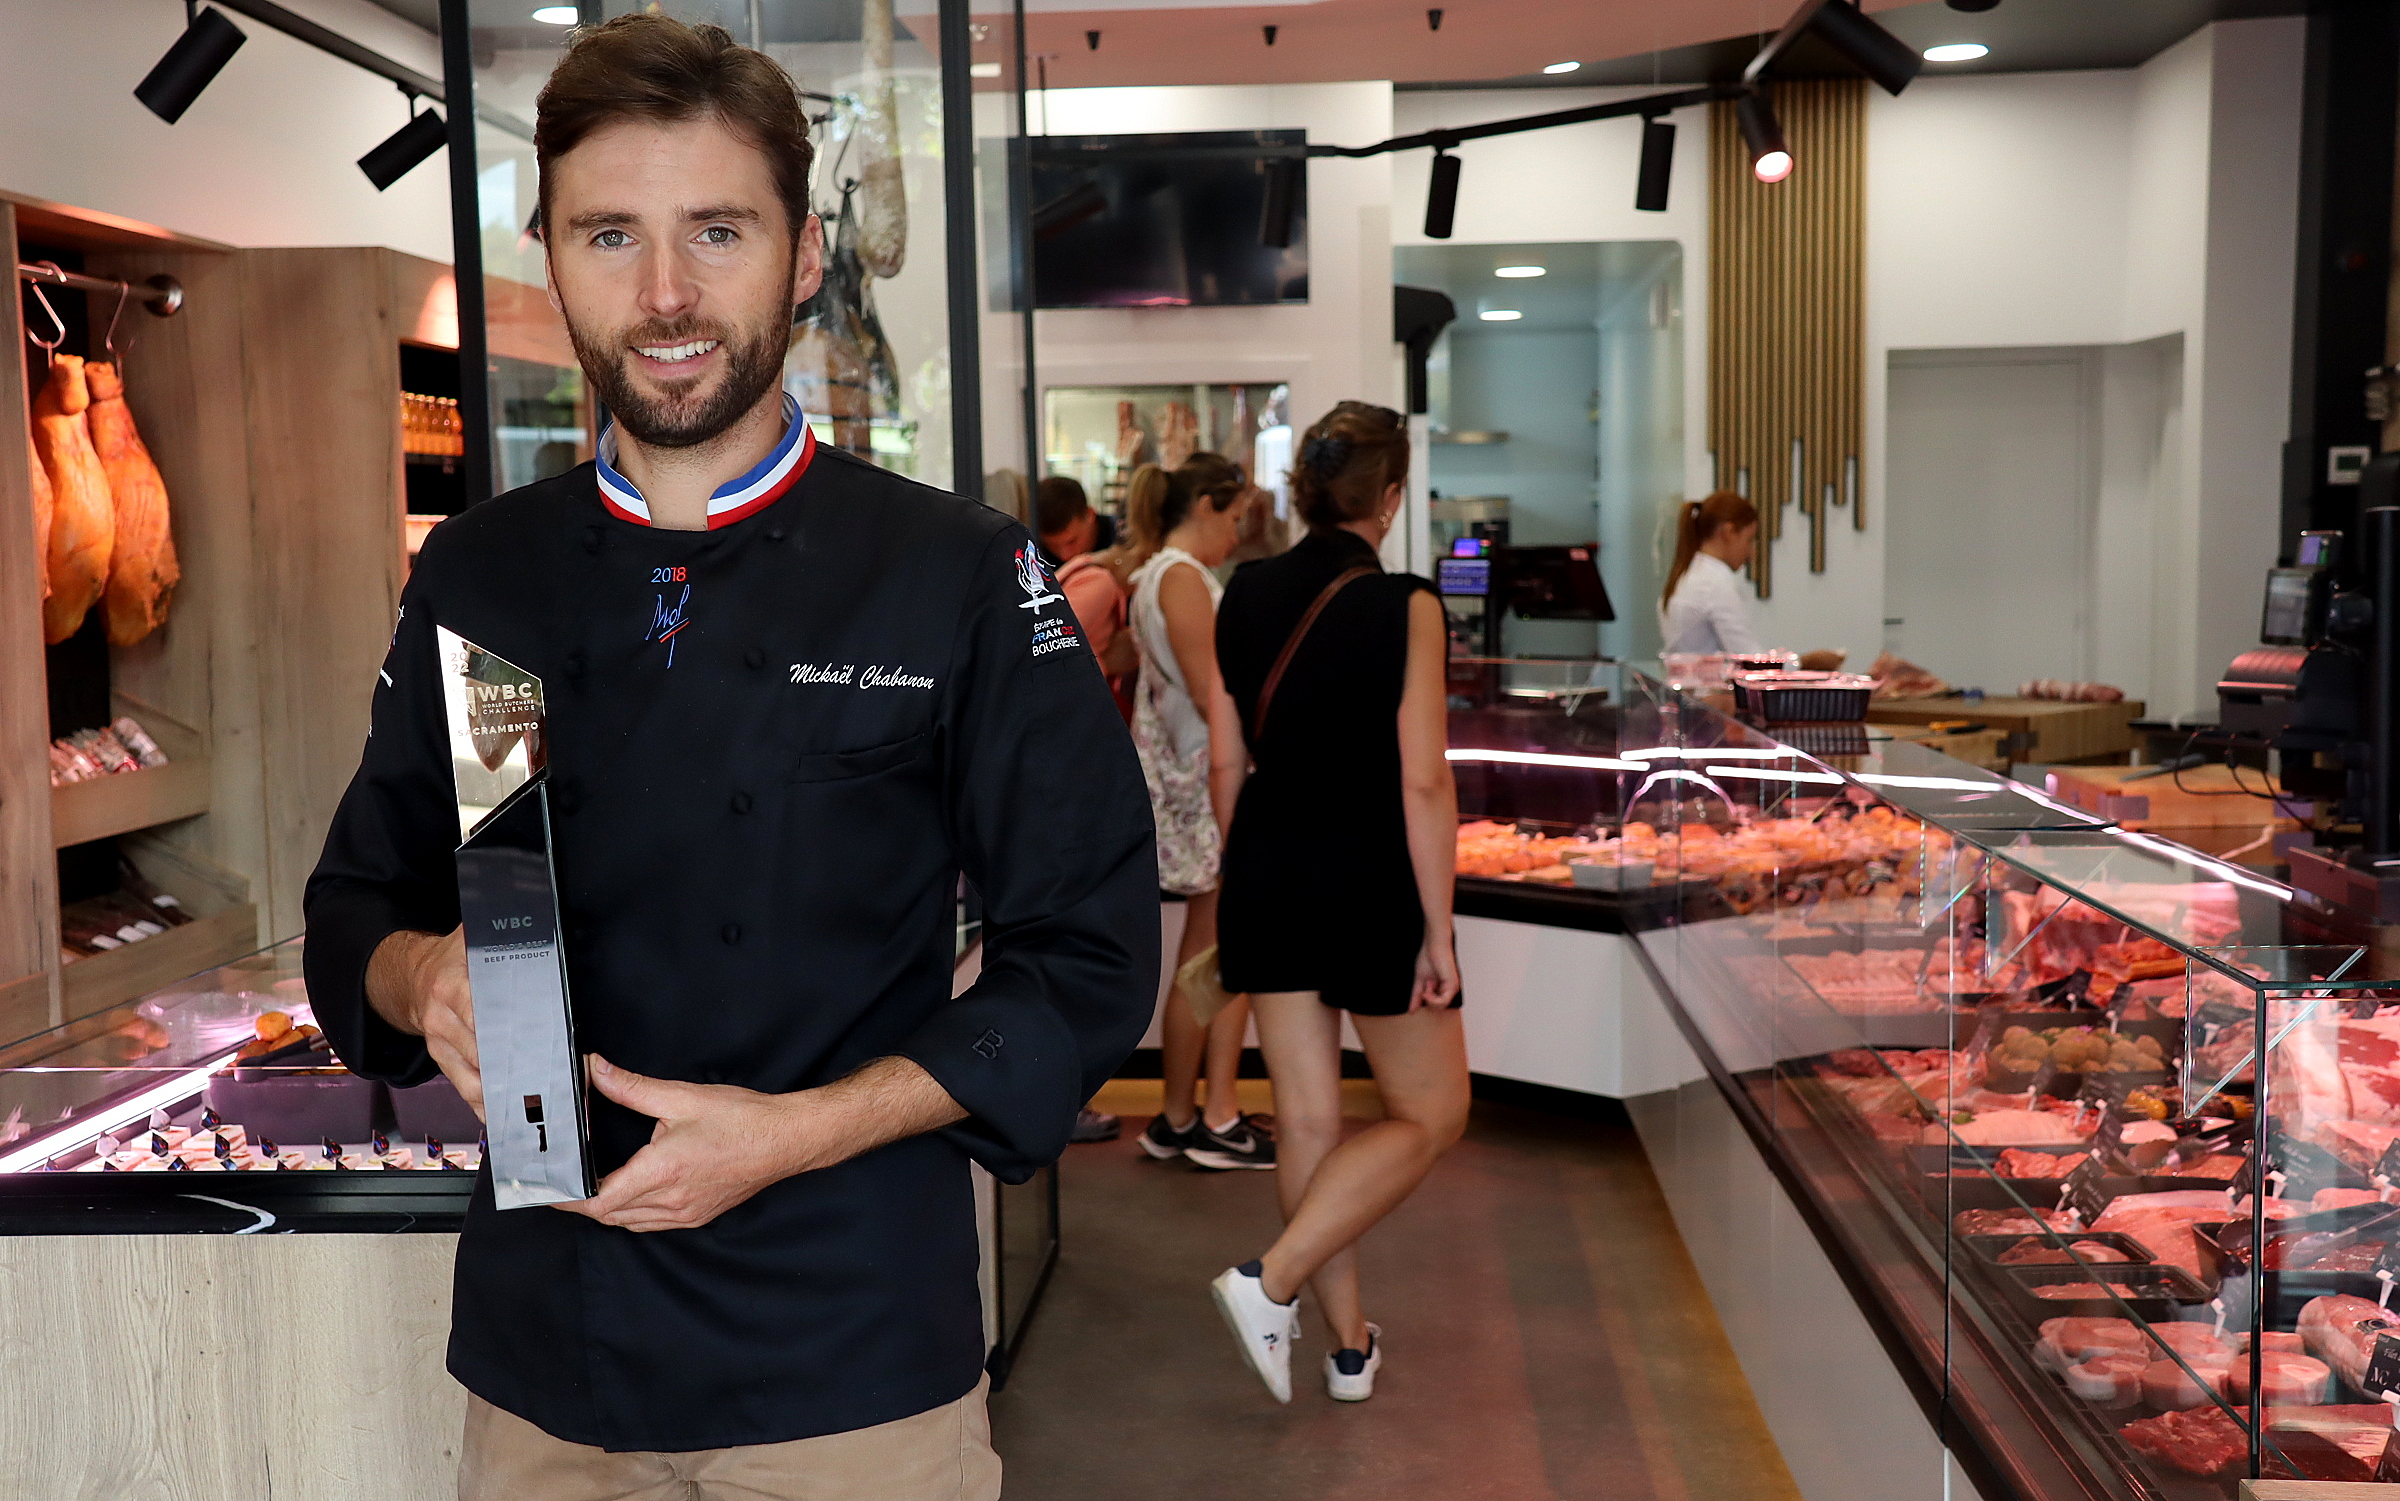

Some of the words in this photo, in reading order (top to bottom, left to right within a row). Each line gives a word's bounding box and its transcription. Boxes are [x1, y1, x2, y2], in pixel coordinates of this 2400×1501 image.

[651, 566, 687, 583] 2018
[1032, 626, 1076, 644] FRANCE
[1032, 636, 1080, 657] BOUCHERIE
[789, 663, 852, 685] Mickaël
[858, 665, 935, 690] Chabanon
[477, 682, 533, 702] WBC
[482, 701, 502, 709] WORLD
[482, 704, 535, 715] CHALLENGE
[458, 721, 539, 737] SACRAMENTO
[492, 916, 533, 931] WBC
[484, 955, 506, 964] BEEF
[509, 950, 550, 961] PRODUCT
